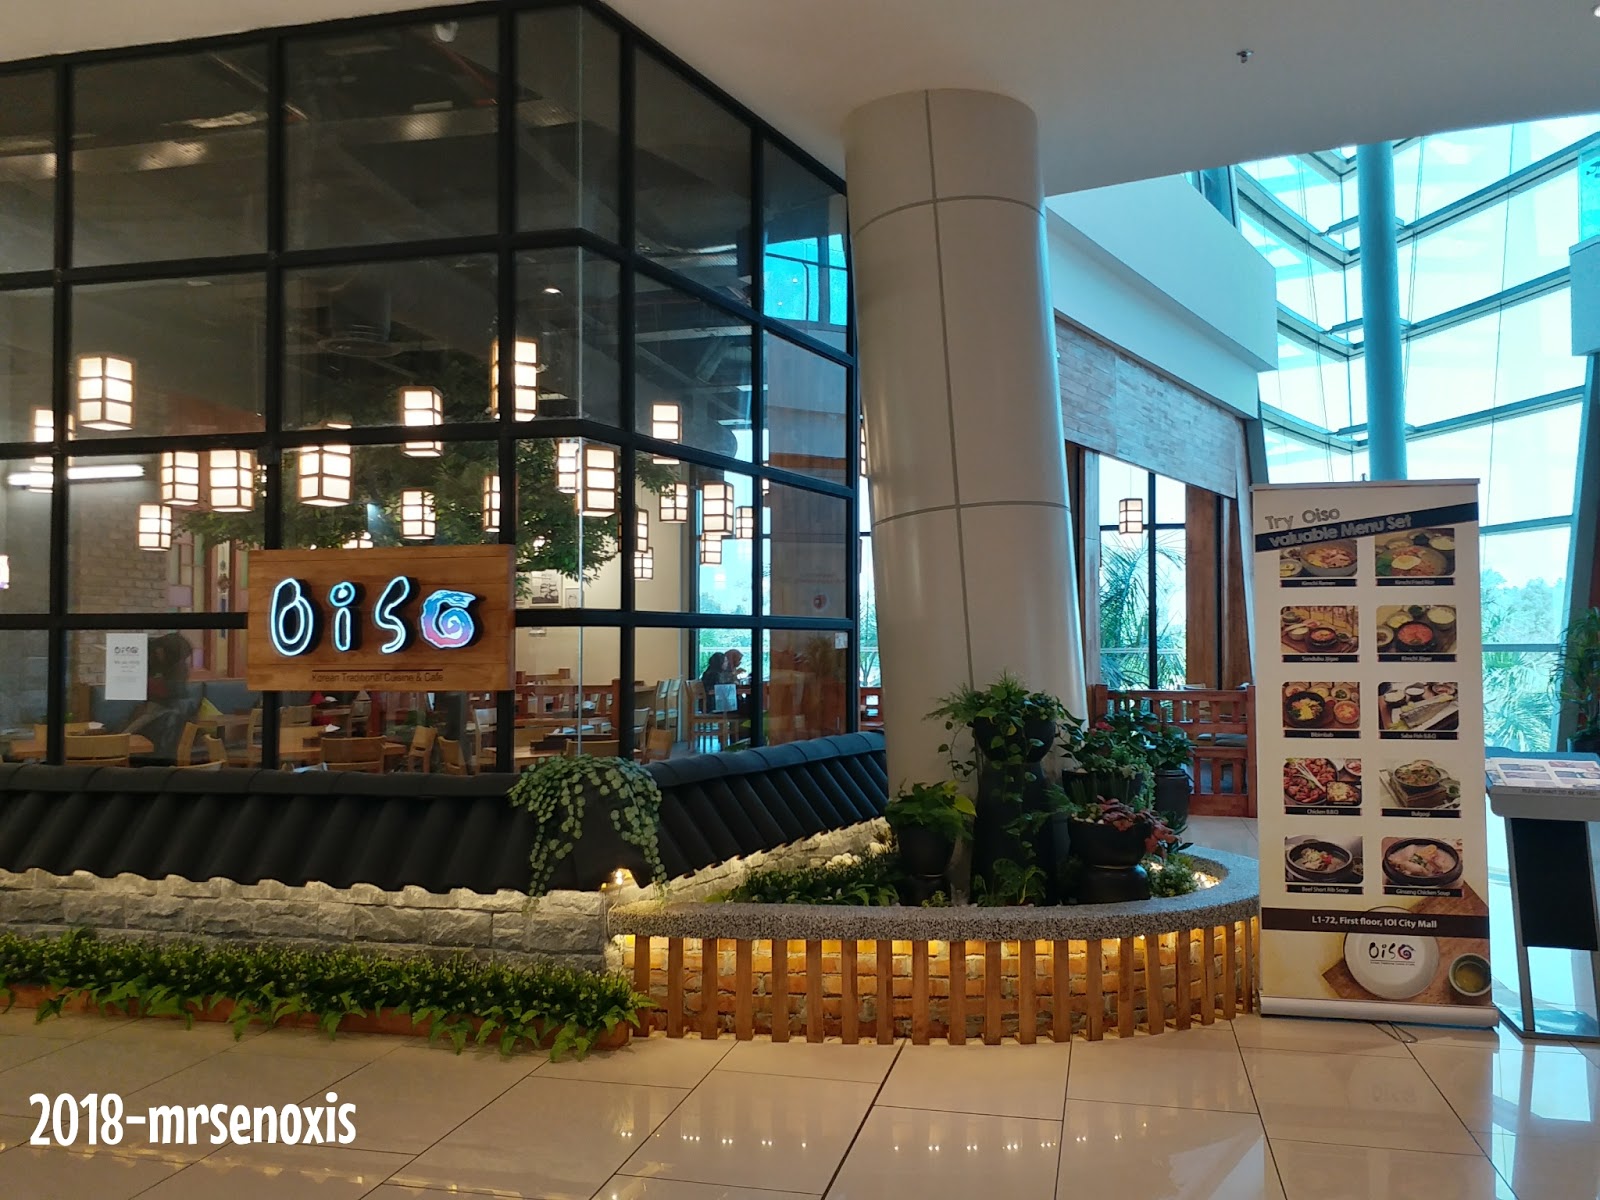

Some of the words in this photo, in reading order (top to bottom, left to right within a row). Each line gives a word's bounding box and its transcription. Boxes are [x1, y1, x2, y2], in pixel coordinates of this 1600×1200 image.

[1264, 515, 1294, 531] Try
[1301, 508, 1341, 524] Oiso
[1340, 520, 1385, 538] Menu
[1386, 514, 1412, 530] Set
[312, 673, 340, 682] Korean
[342, 672, 381, 682] Traditional
[384, 672, 415, 682] Cuisine
[1312, 915, 1338, 925] L1-72,
[1340, 917, 1359, 925] First
[1360, 917, 1383, 927] floor,
[1398, 919, 1416, 928] City
[1418, 920, 1438, 928] Mall
